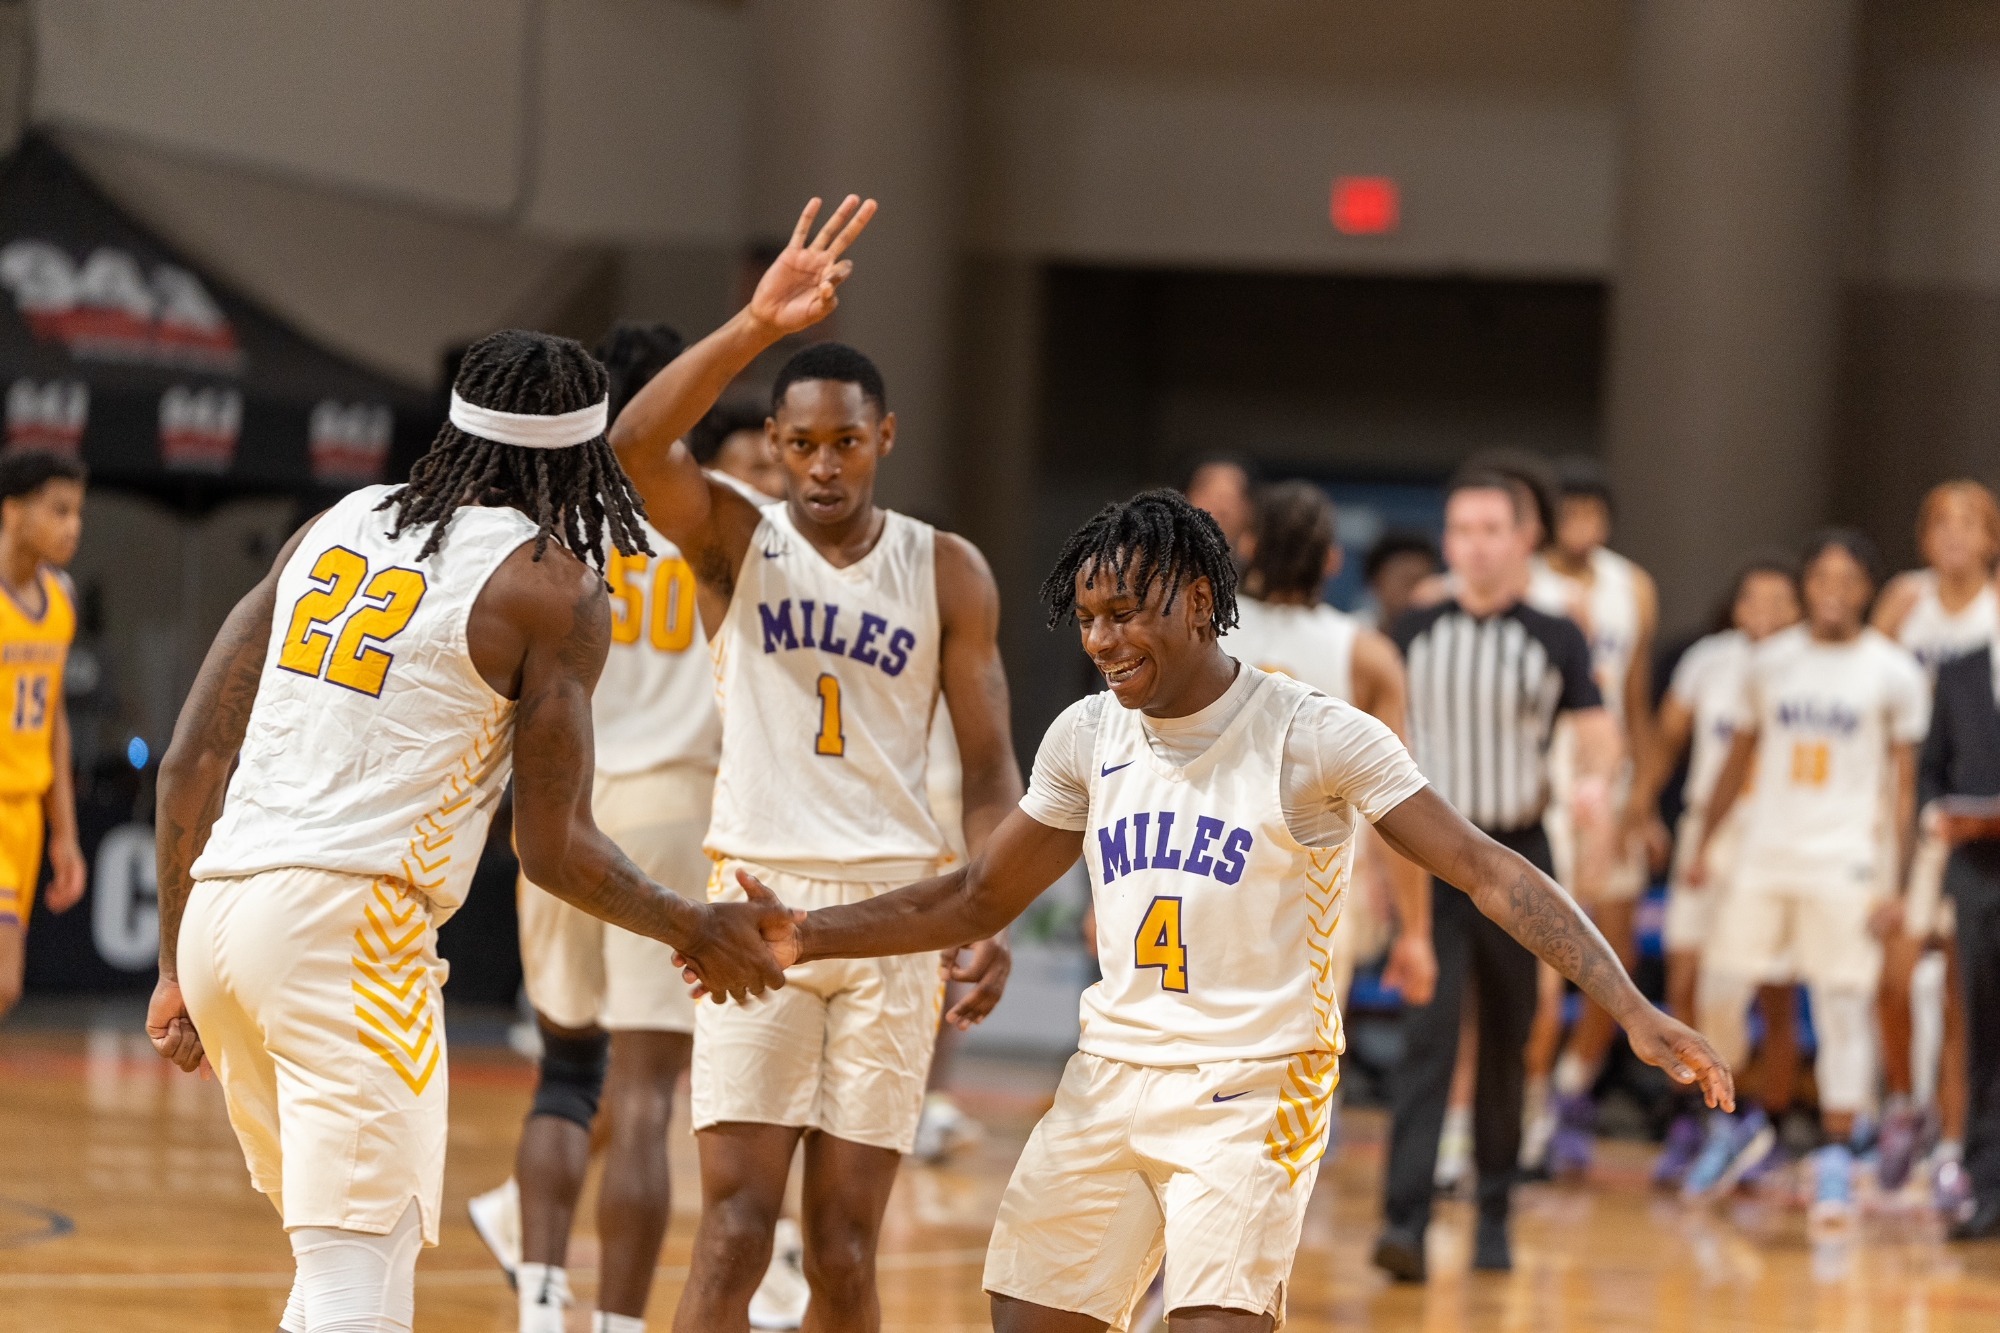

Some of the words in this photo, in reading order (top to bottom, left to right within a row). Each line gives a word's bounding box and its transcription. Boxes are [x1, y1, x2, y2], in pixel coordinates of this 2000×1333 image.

[277, 545, 428, 699] 22
[608, 545, 698, 655] 50
[758, 598, 916, 678] MILES
[815, 672, 845, 757] 1
[1098, 811, 1254, 886] MILES
[1134, 895, 1189, 994] 4
